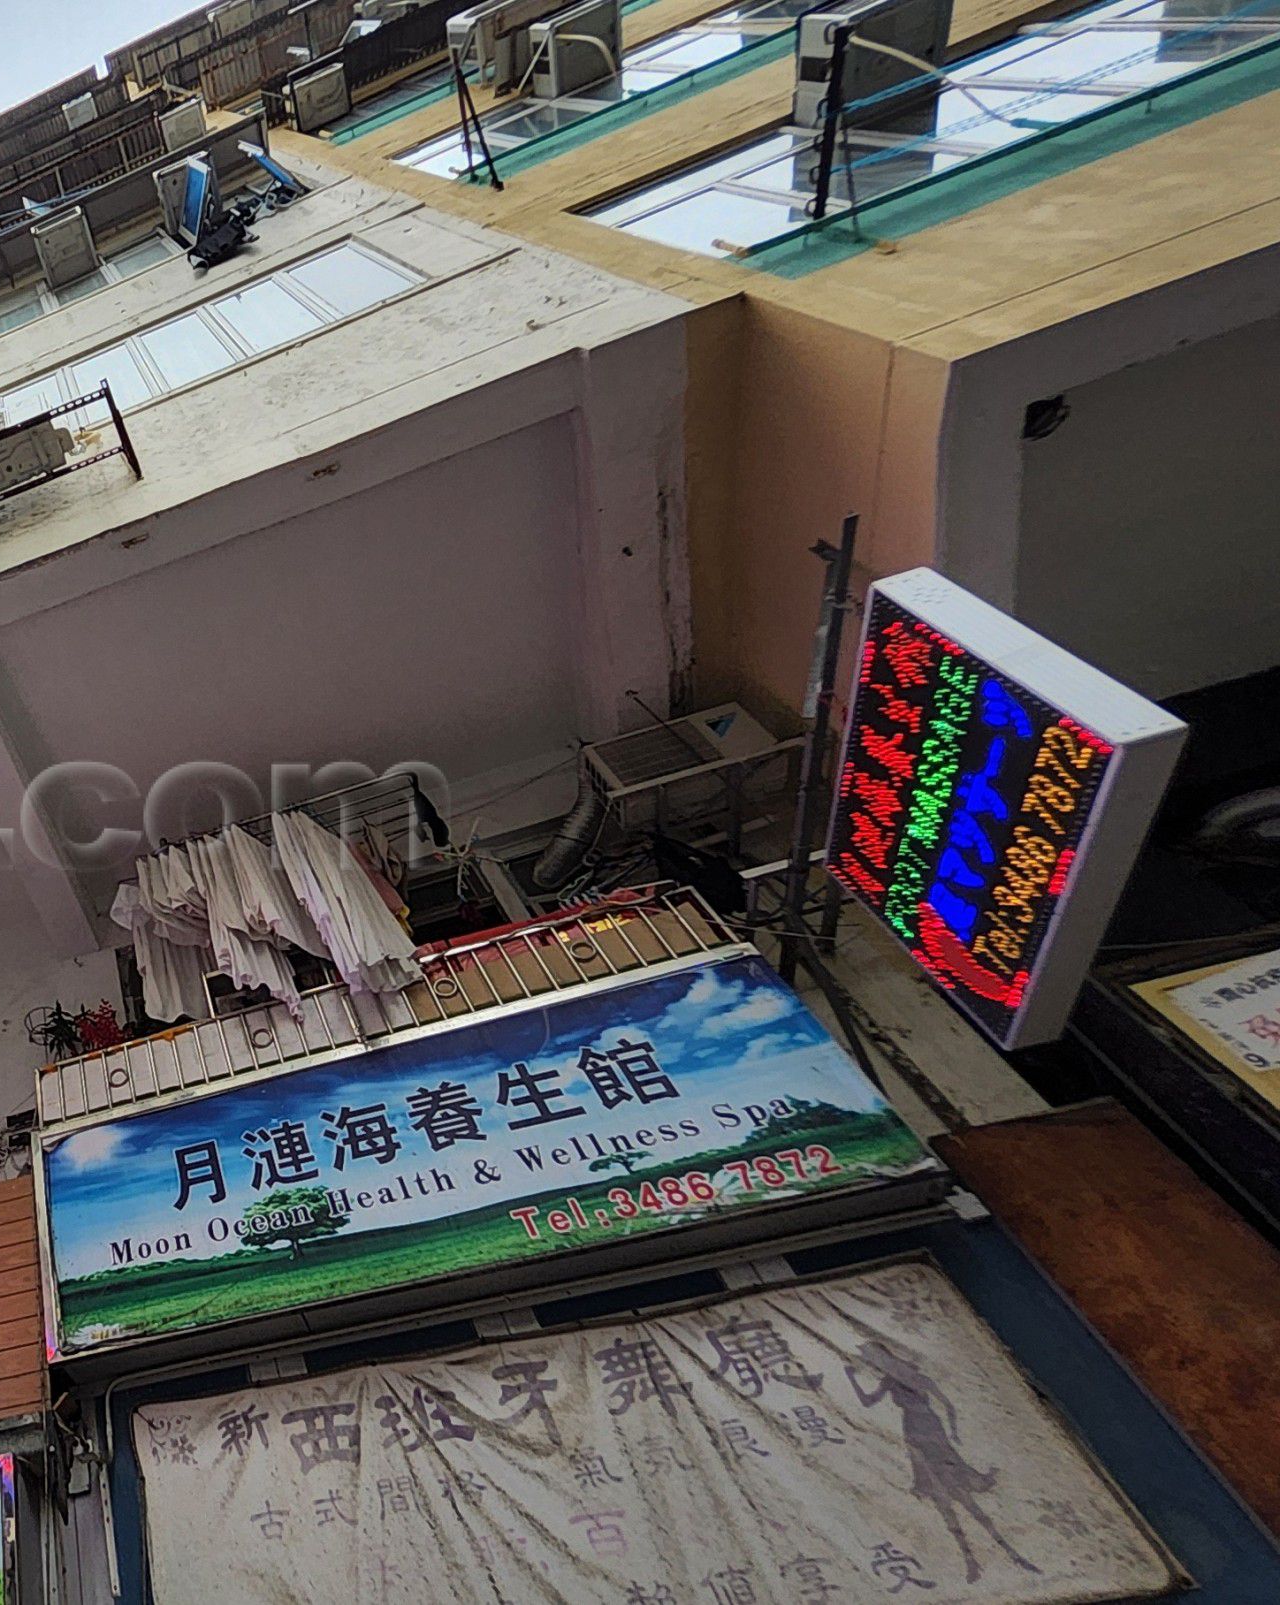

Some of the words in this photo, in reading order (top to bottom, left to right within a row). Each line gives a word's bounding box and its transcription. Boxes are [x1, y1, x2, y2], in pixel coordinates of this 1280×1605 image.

[907, 656, 977, 848] MASSAGE
[109, 1232, 192, 1267] Moon
[207, 1203, 315, 1242] Ocean
[326, 1167, 456, 1218] Health
[473, 1158, 503, 1186] &
[512, 1116, 701, 1173] Wellness
[711, 1096, 795, 1130] Spa
[173, 1037, 682, 1211] 月漣海養生館
[724, 1143, 843, 1194] 7872
